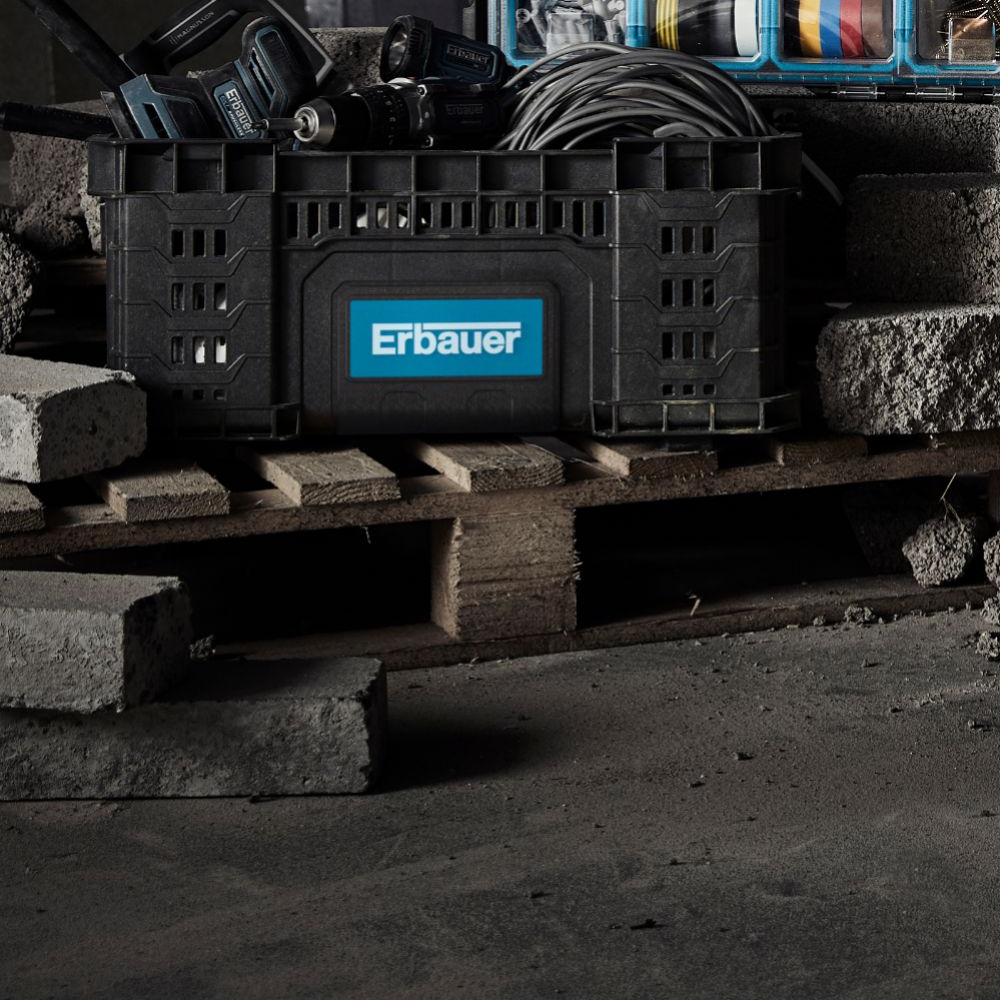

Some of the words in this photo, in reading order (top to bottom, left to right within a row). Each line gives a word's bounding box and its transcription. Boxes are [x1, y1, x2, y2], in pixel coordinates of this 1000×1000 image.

[446, 43, 490, 65] Erbauer
[225, 88, 257, 134] Erbauer
[372, 321, 522, 356] Erbauer
